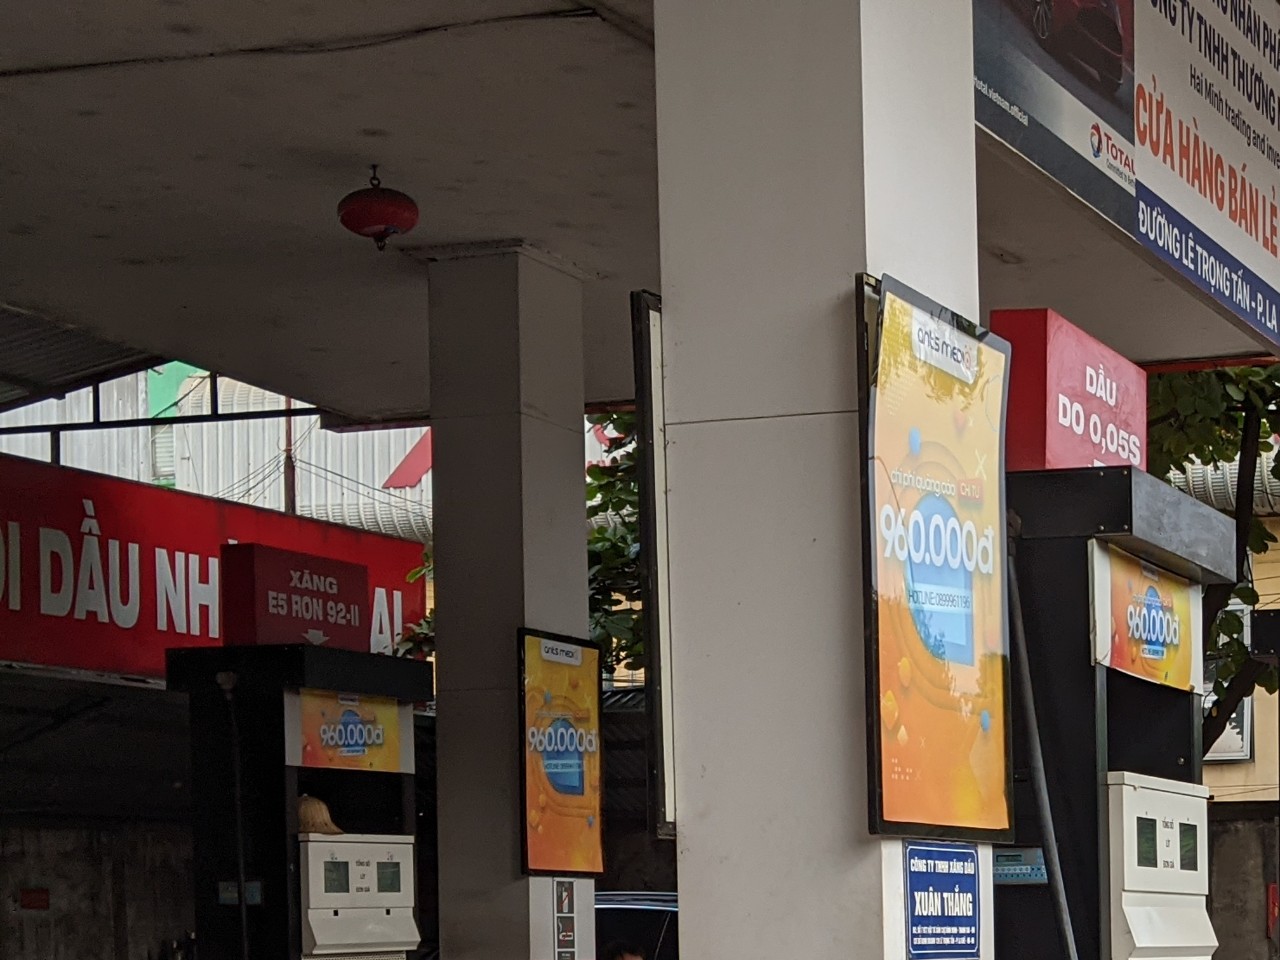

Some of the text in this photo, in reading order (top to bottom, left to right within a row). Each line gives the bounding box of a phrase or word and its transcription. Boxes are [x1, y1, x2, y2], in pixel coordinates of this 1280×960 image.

[1196, 11, 1229, 80] TNHH
[1230, 46, 1276, 126] THƯƠNG
[1204, 78, 1224, 116] Minh
[1225, 98, 1251, 147] trading
[1252, 129, 1265, 155] and
[1135, 74, 1175, 172] CỬA
[1178, 116, 1225, 212] HÀNG
[1228, 162, 1258, 242] BÁN
[1262, 185, 1278, 259] LẺ
[1138, 200, 1180, 259] ĐƯỜNG
[1181, 232, 1195, 271] LÊ
[1195, 244, 1230, 297] TRỌNG
[1231, 269, 1250, 313] TẤN
[1085, 363, 1116, 407] DẦU
[1058, 393, 1141, 467] DO 0,05S
[880, 504, 995, 574] 960.000đ
[38, 498, 140, 629] DẦU
[154, 547, 220, 639] NH
[289, 569, 338, 594] XĂNG
[268, 590, 288, 615] E5
[291, 594, 324, 621] RON
[1127, 604, 1179, 645] 960.000đ
[320, 723, 384, 746] 960.000đ
[528, 726, 596, 752] 960.000đ
[914, 885, 973, 916] XUÂN THẮNG
